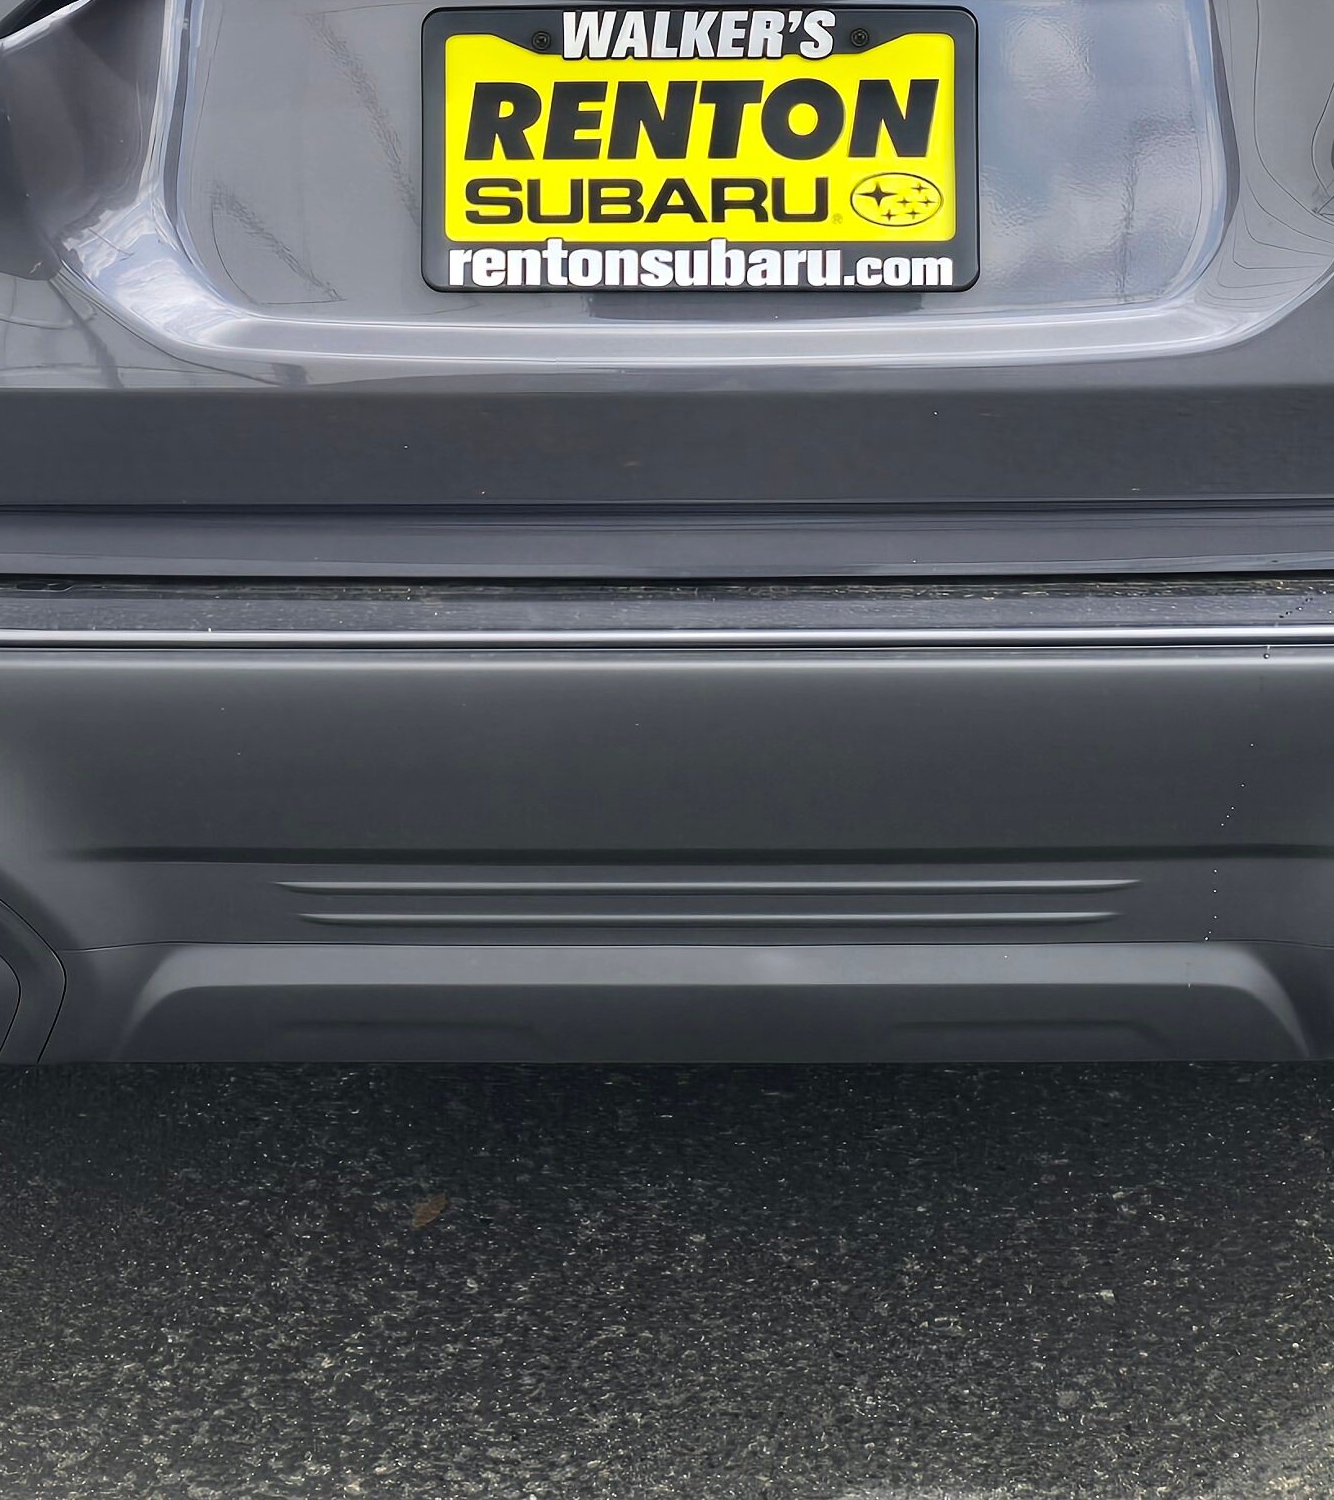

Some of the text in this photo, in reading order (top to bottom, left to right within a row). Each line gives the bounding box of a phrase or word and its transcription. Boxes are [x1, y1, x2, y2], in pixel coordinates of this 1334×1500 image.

[562, 9, 837, 60] WALKER'S
[464, 77, 940, 162] RENTON
[465, 176, 830, 224] SUBARU
[448, 237, 954, 287] rentonsubaru.com
